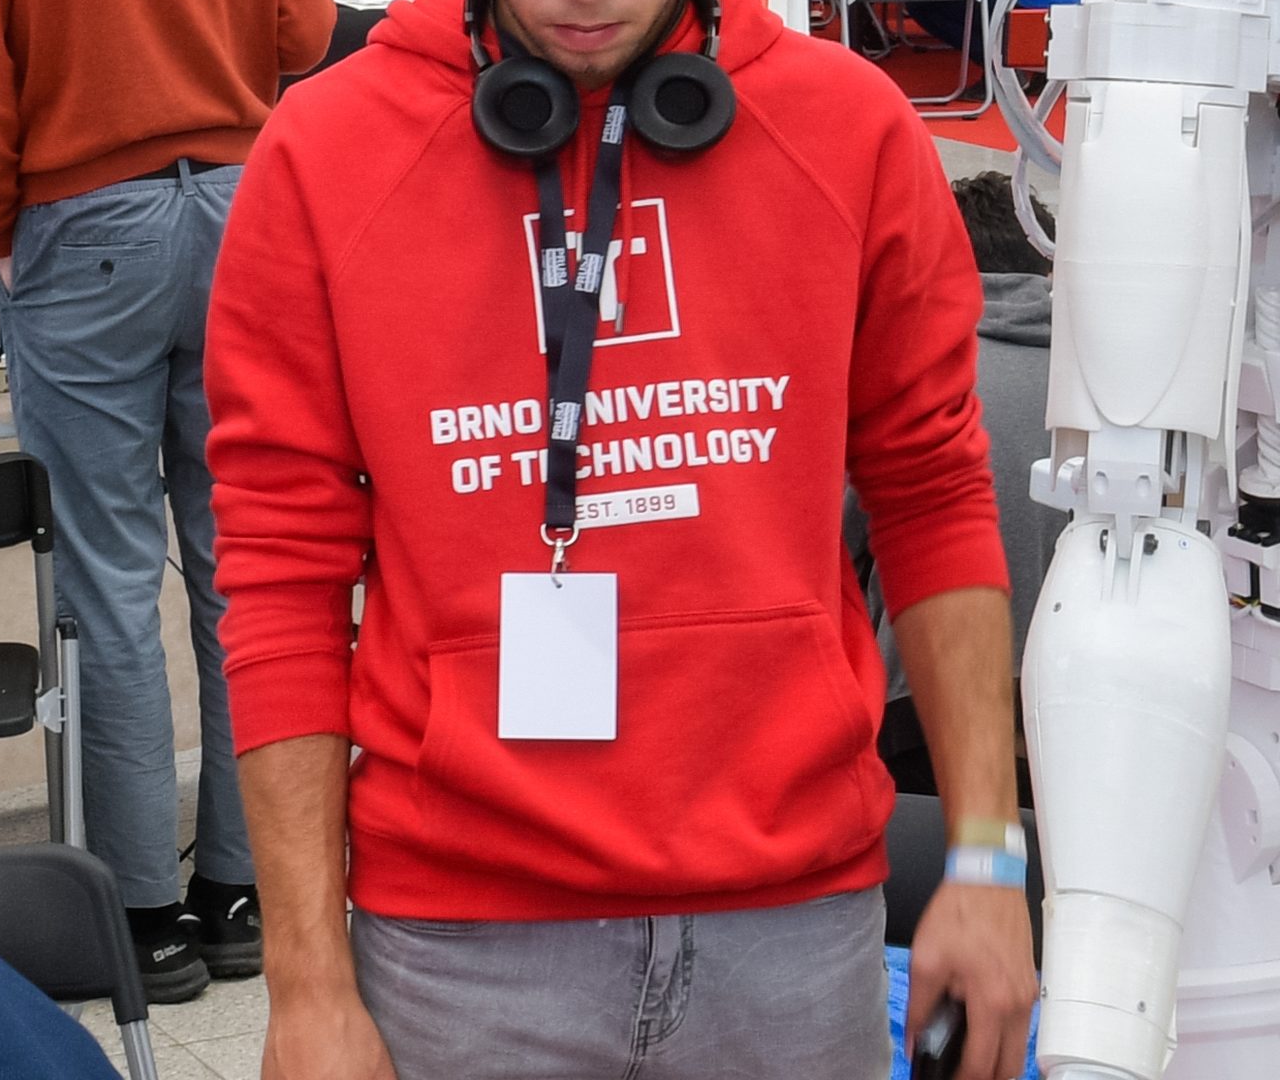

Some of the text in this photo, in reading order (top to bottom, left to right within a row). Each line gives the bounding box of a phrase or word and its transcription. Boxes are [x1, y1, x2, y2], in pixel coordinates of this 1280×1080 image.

[429, 398, 542, 445] BRNO
[584, 375, 791, 427] NIVERSITY
[451, 427, 777, 494] OF TCHNOLOGY
[575, 493, 677, 521] EST. 1899
